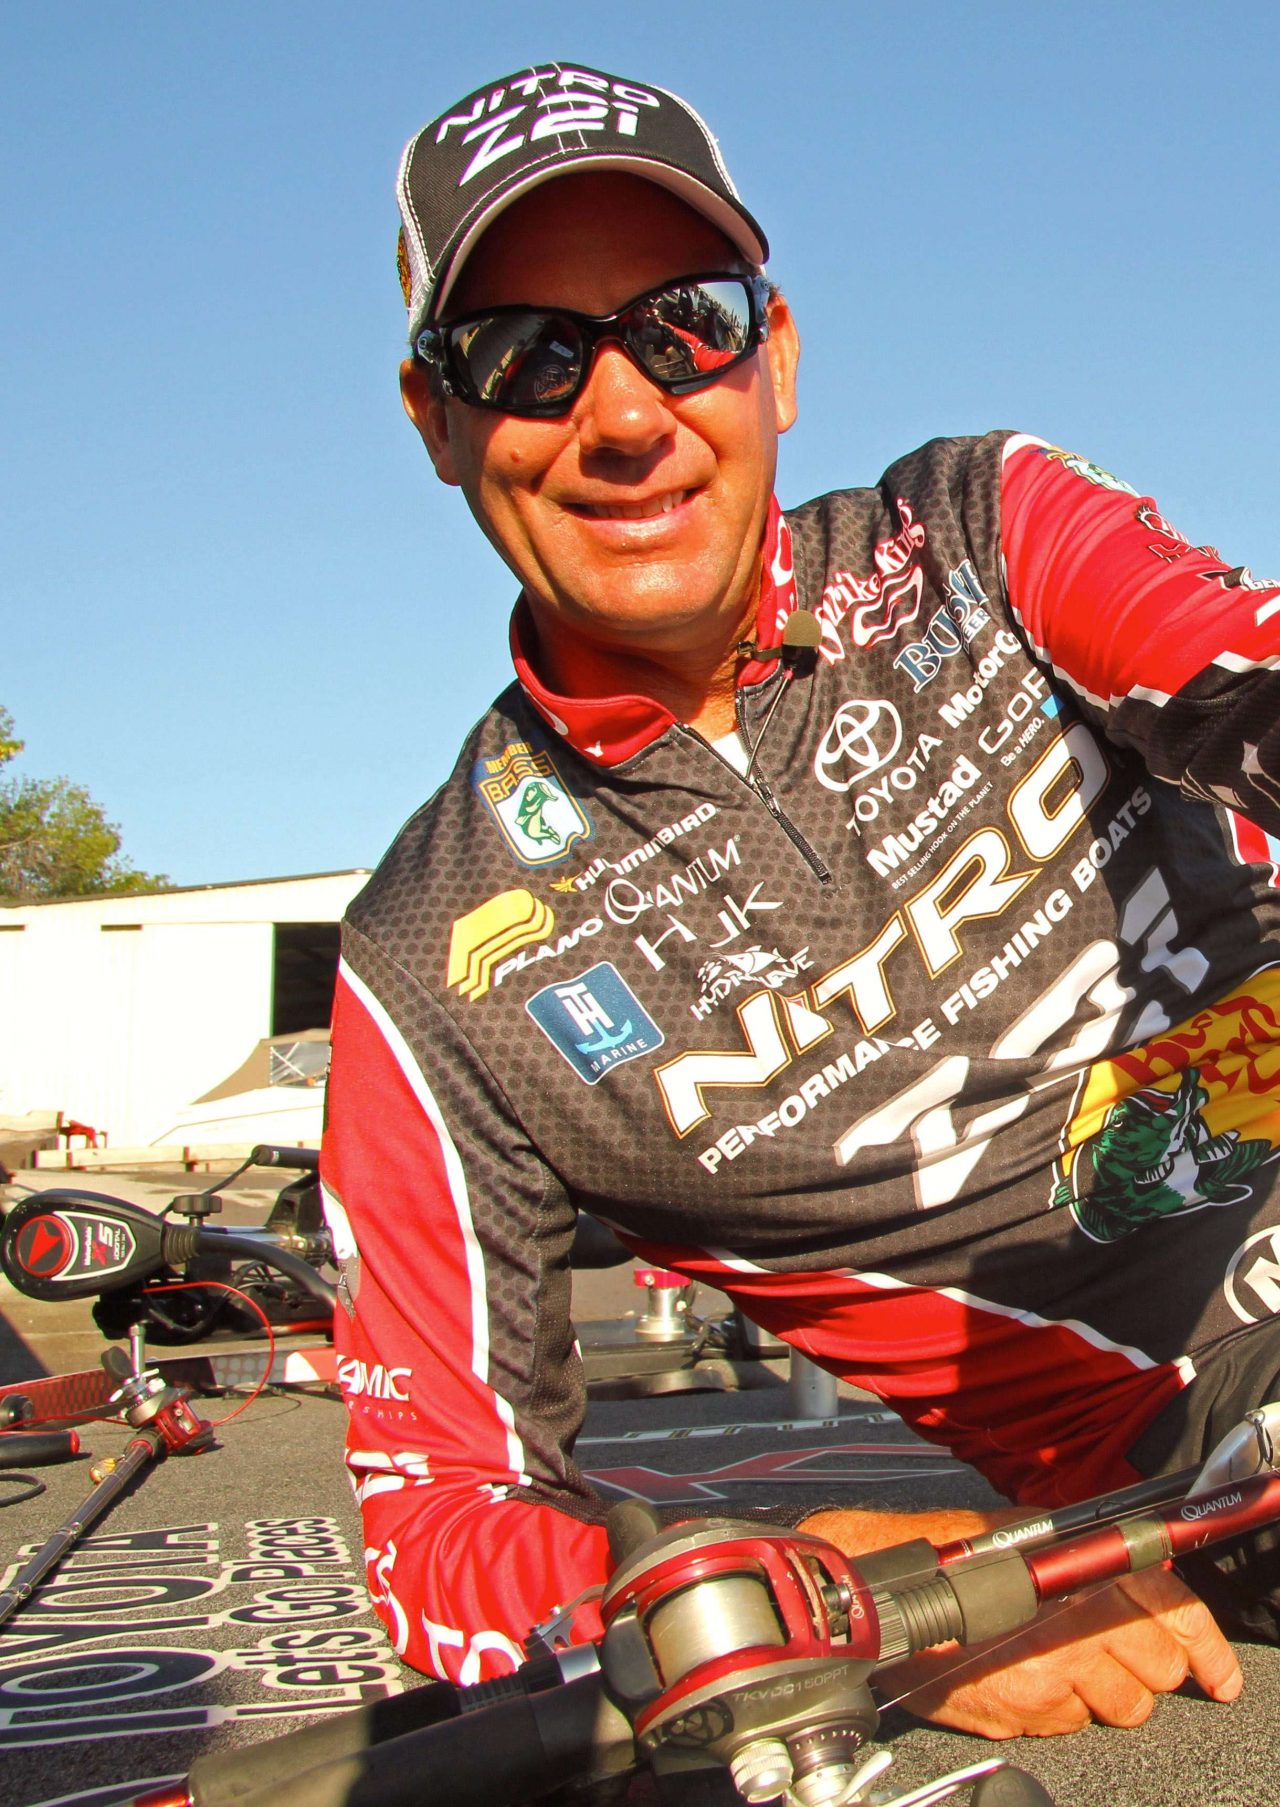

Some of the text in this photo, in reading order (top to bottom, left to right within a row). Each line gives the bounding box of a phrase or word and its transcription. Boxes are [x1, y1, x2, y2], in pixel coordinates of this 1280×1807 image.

[436, 70, 660, 143] NITRO
[874, 497, 926, 578] King
[962, 606, 992, 650] EER
[938, 629, 1022, 729] MotorG
[485, 742, 533, 774] MEMBER
[845, 733, 943, 837] TOYOTA
[1000, 752, 1017, 768] Be
[575, 802, 717, 892] HUMMINBIRD
[866, 754, 982, 878] Mustad
[891, 781, 994, 890] BEST SELLING HOOK ON THE PLANET
[653, 722, 1112, 1140] NITRO
[940, 888, 1075, 1027] FISHING
[1070, 785, 1153, 893] BOATS
[494, 917, 604, 988] PLANO
[590, 1037, 649, 1075] MARINE
[337, 1354, 413, 1402] AMIC
[991, 1518, 1054, 1550] QUANTUM
[1180, 1491, 1243, 1522] QUANTUM
[220, 1515, 357, 1585] Places
[227, 1582, 369, 1630] Go
[227, 1628, 403, 1718] Let's
